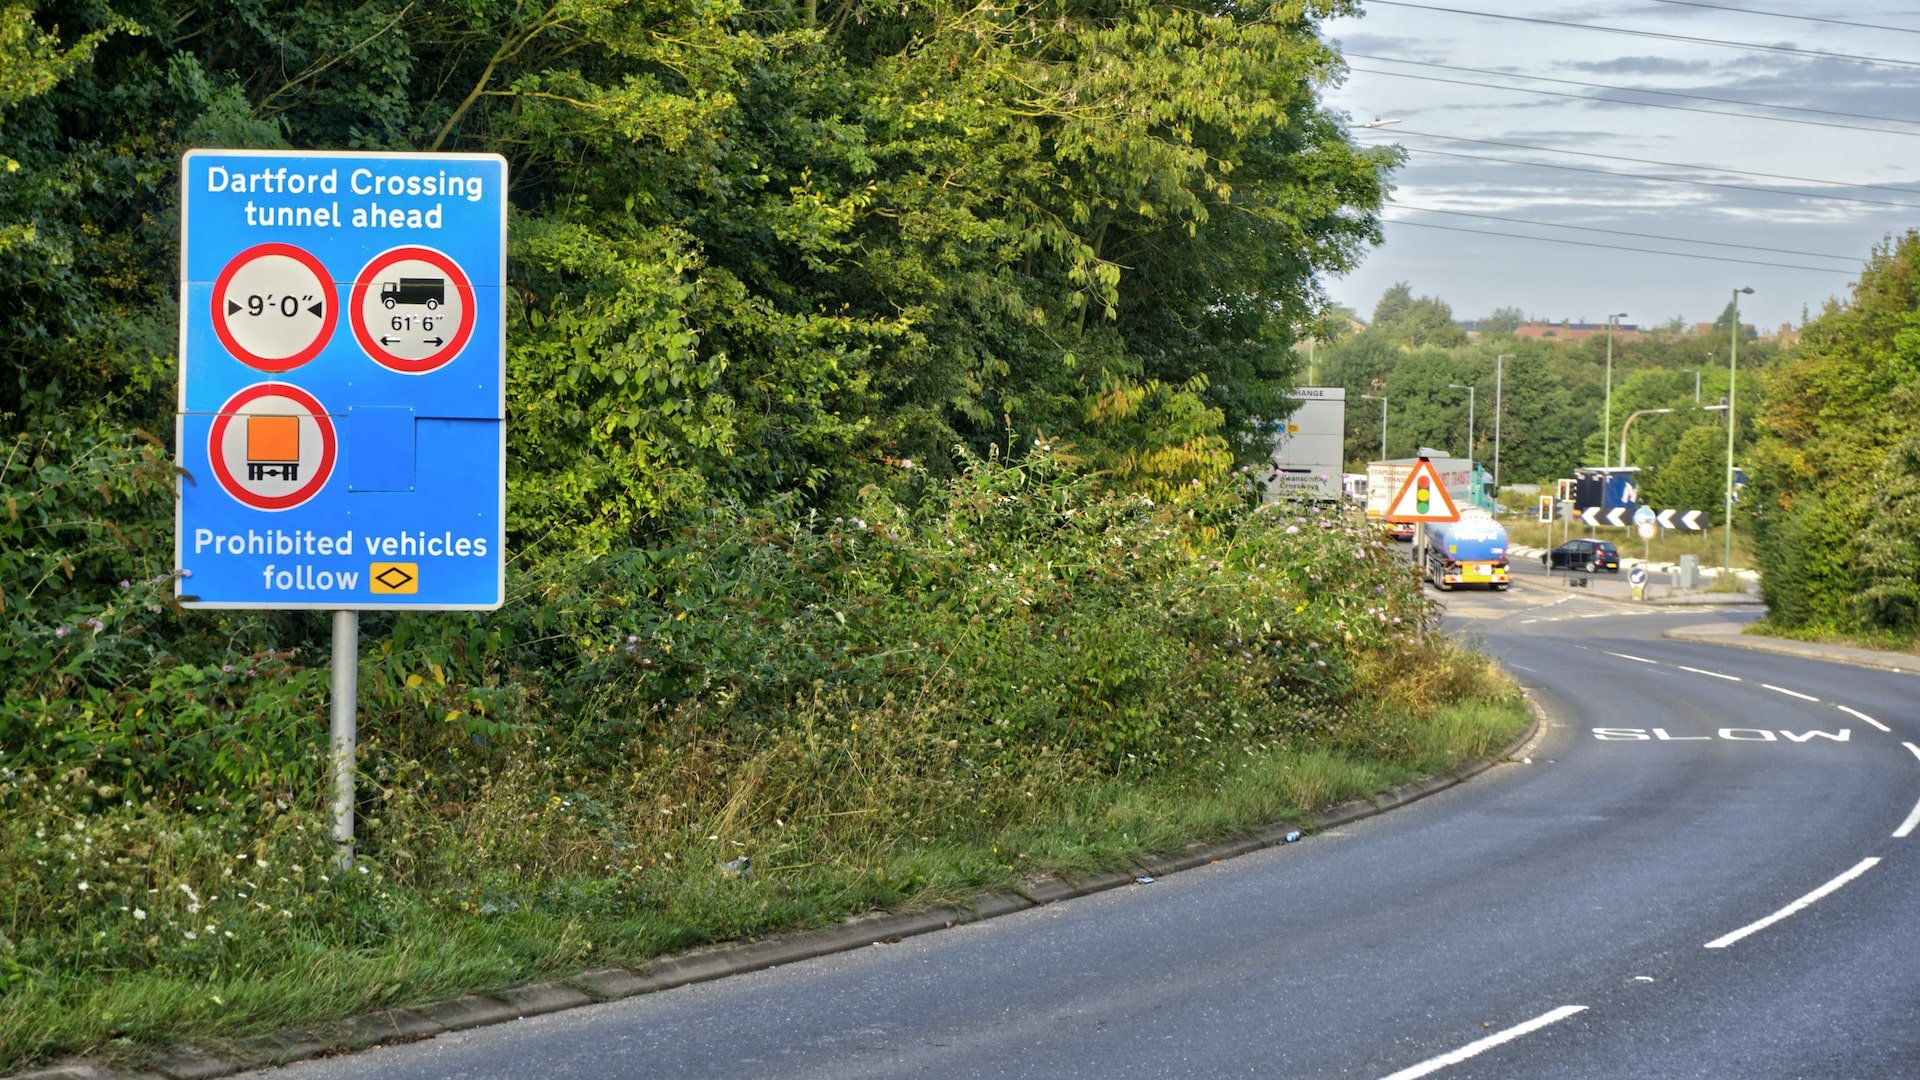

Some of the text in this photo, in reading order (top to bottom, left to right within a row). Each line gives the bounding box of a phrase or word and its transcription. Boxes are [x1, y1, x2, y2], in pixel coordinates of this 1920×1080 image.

[208, 166, 483, 201] Dartford Crossing
[244, 201, 442, 229] tunnel ahead
[195, 529, 487, 557] Prohibited vehicles
[263, 565, 359, 590] follow
[1592, 728, 1851, 742] SLOW
